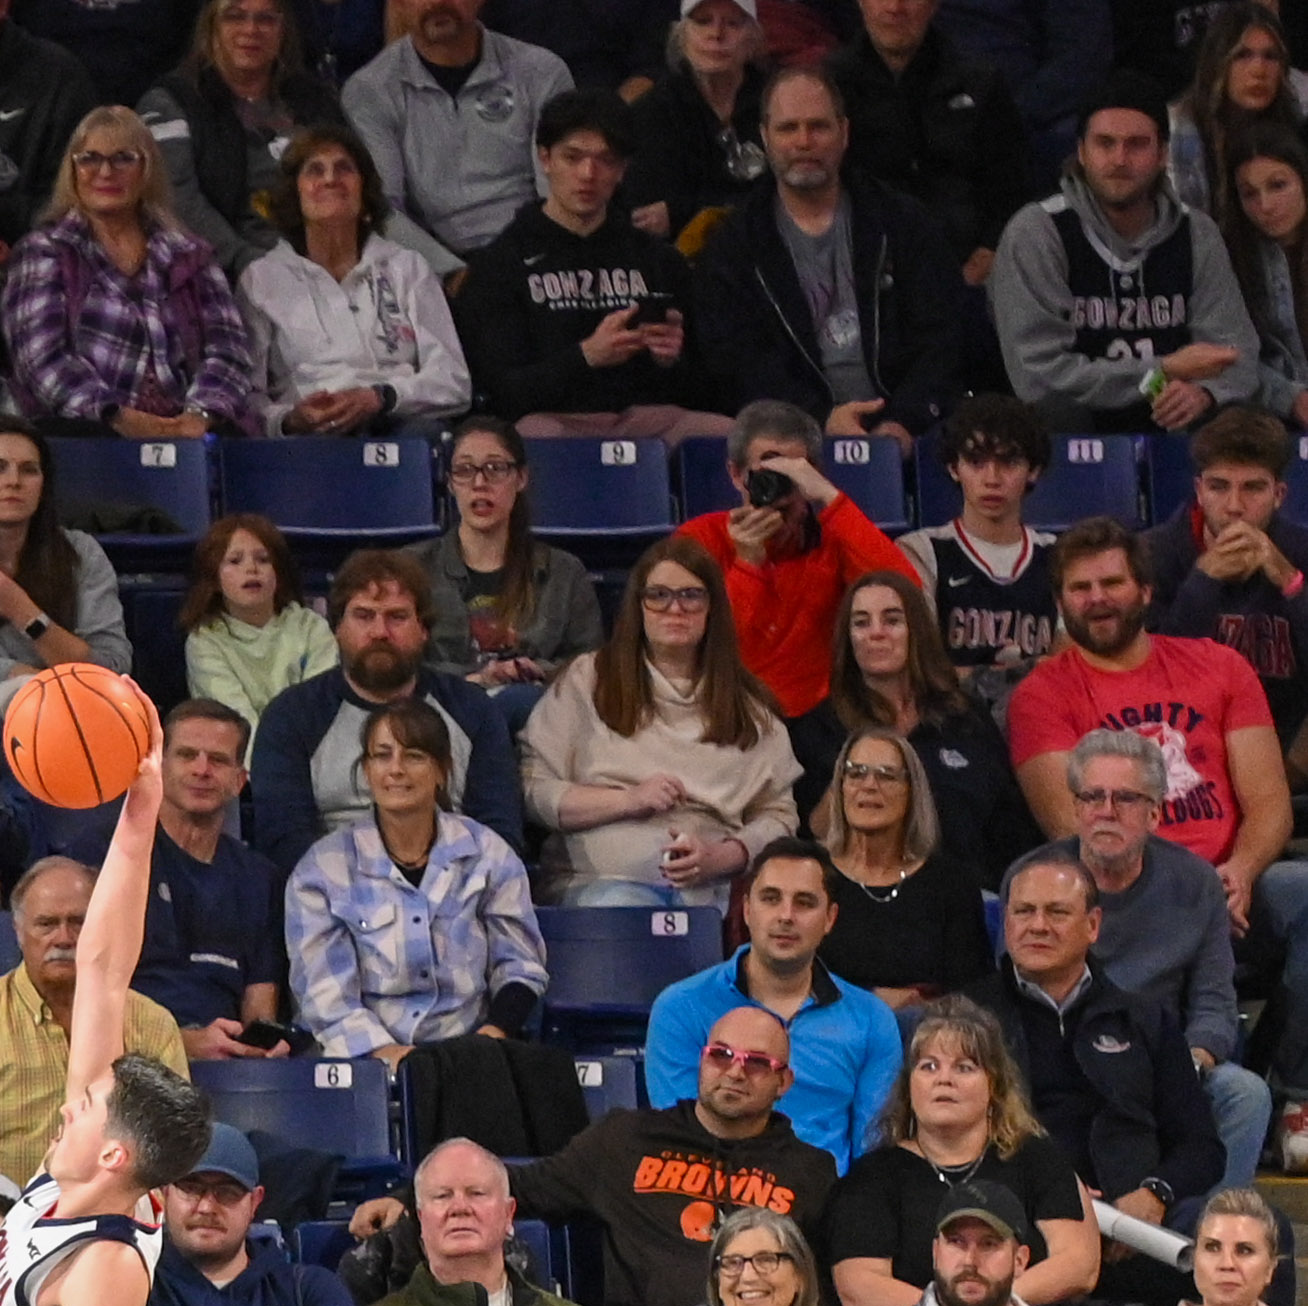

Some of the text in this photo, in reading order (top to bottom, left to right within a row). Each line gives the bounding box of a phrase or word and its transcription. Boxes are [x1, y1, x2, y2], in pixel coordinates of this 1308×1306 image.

[528, 267, 649, 303] GONZAGA
[1071, 293, 1185, 330] GONZAGA
[149, 445, 164, 465] 7
[375, 443, 387, 465] 8
[612, 443, 624, 464] 9
[840, 443, 863, 464] 10
[663, 913, 676, 935] 8
[327, 1064, 339, 1087] 6
[577, 1064, 589, 1085] 7
[660, 1150, 776, 1184] CLEVEAND
[634, 1155, 795, 1215] BROWNS
